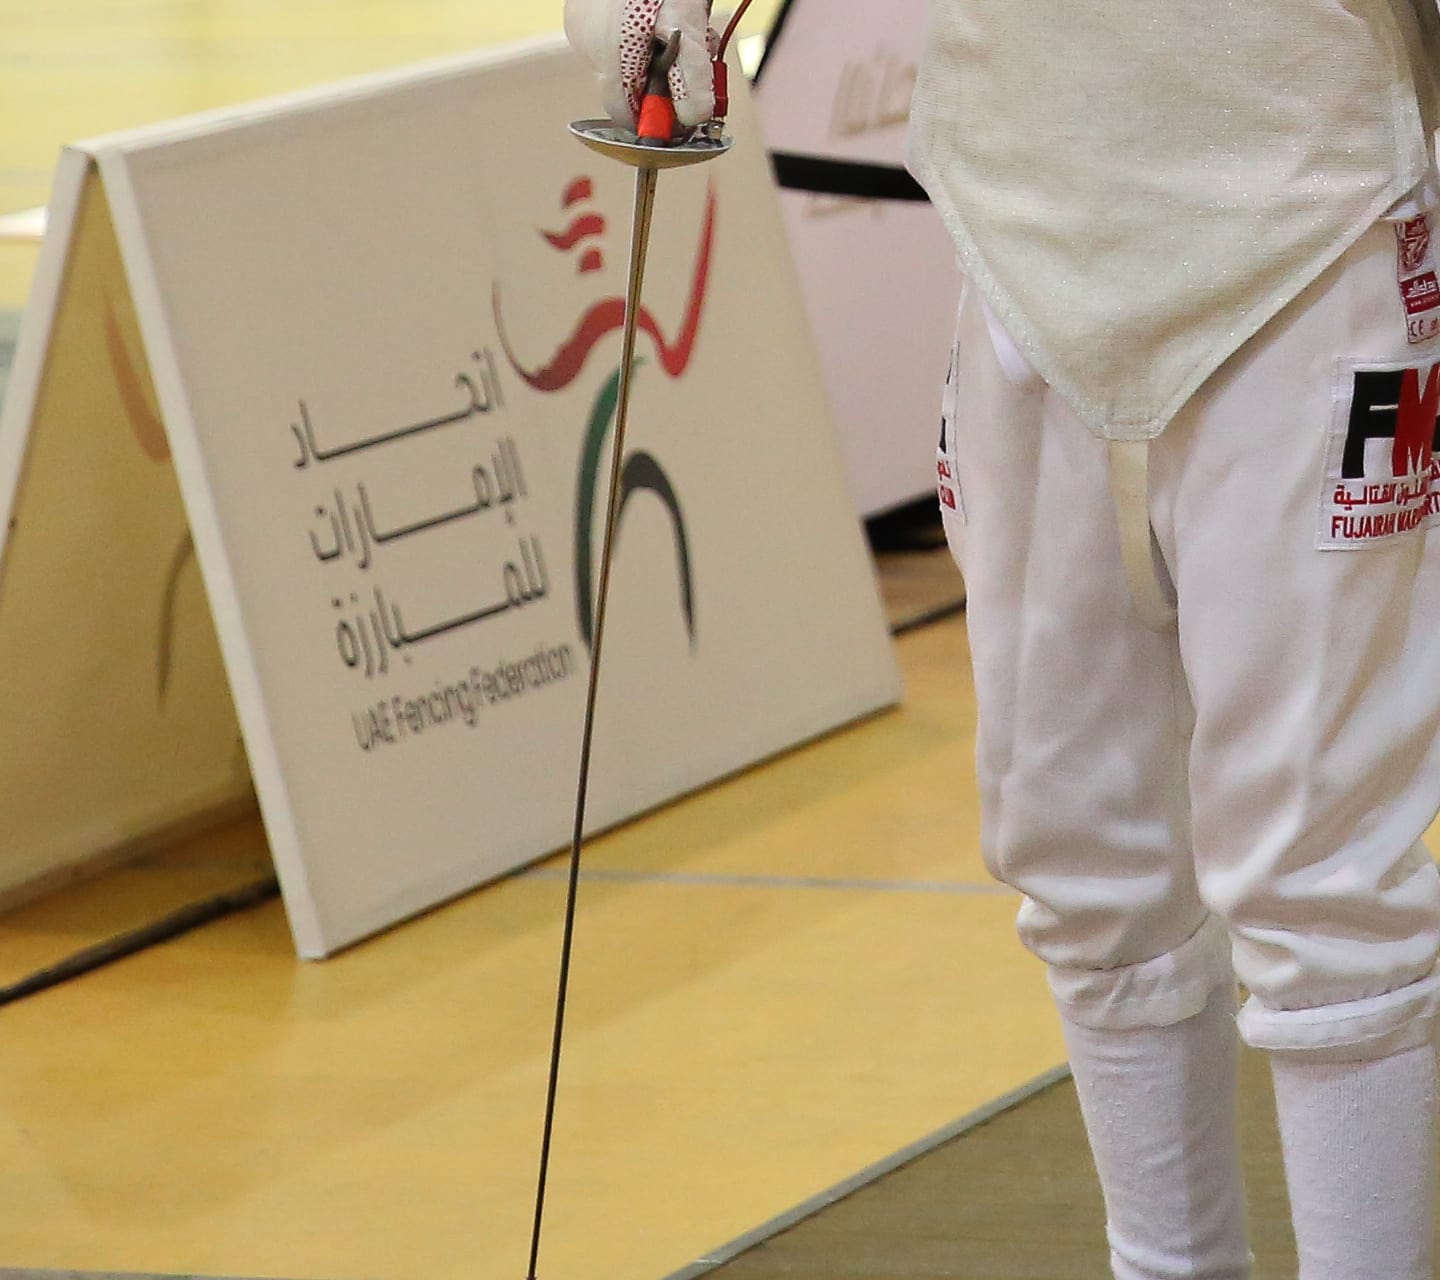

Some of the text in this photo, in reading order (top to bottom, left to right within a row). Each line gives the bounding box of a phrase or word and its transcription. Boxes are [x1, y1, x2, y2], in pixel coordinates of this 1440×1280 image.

[290, 345, 504, 470] اتحاد
[351, 698, 396, 751] UAE
[391, 681, 479, 728] Fencing
